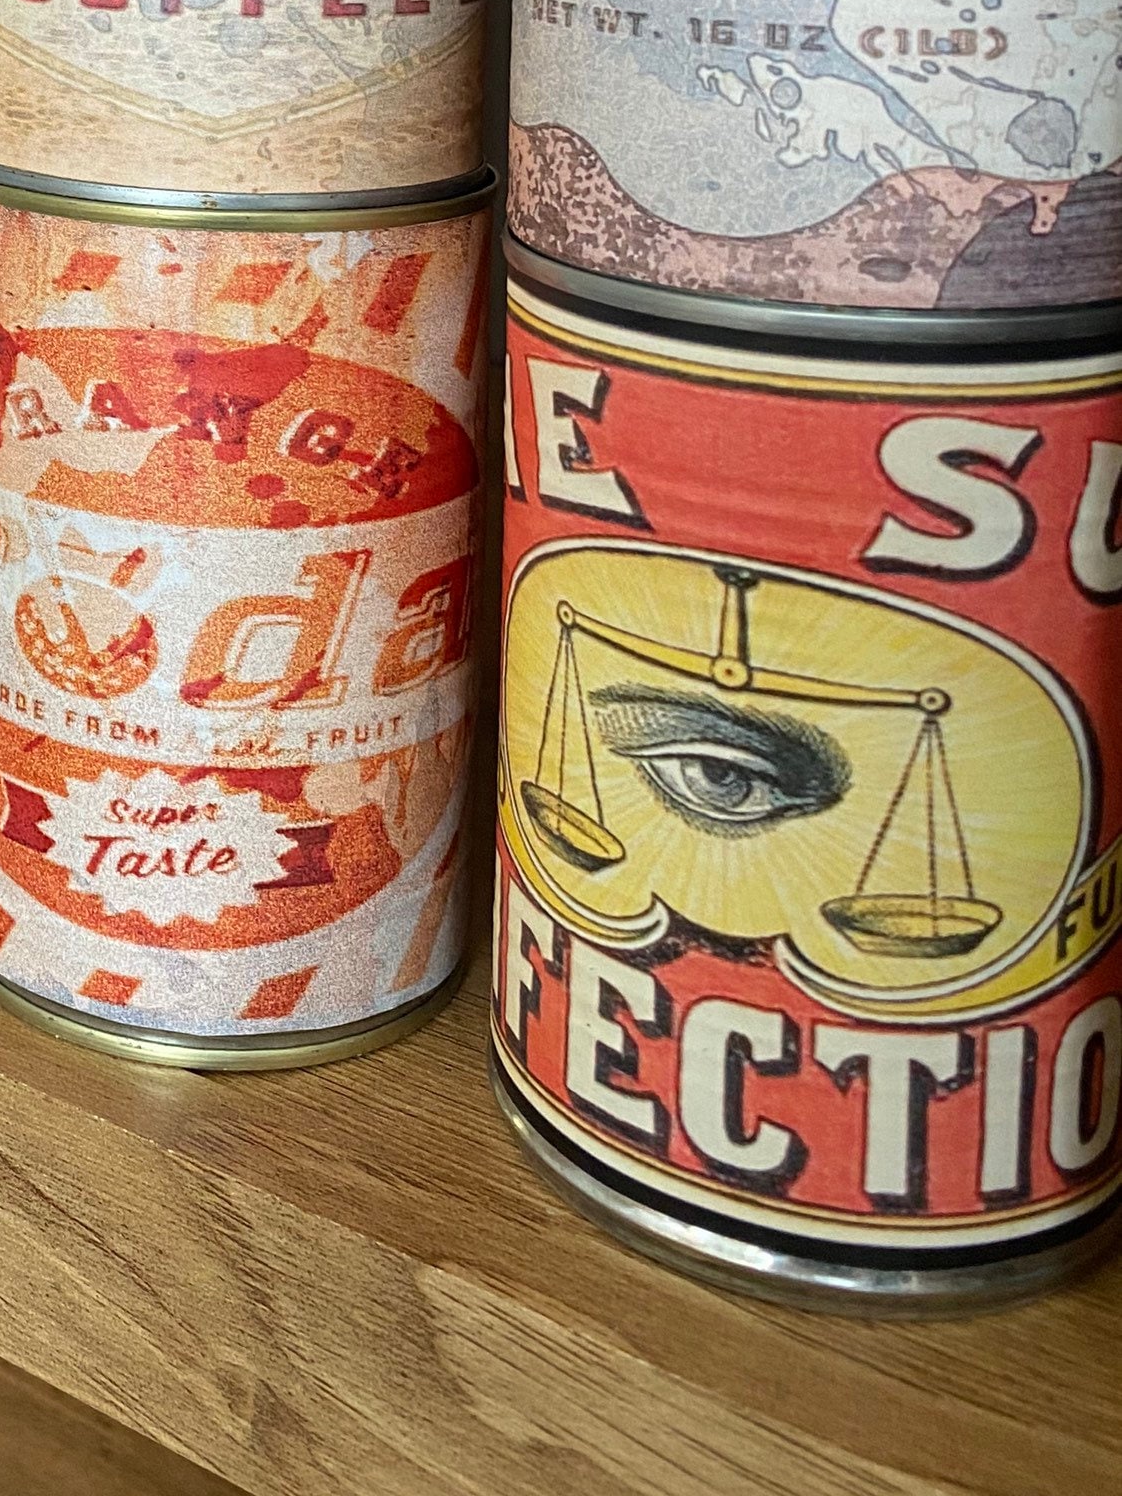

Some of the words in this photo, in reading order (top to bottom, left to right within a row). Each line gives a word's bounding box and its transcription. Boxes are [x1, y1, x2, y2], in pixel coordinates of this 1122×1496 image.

[506, 354, 654, 534] E
[65, 708, 161, 748] FROM
[306, 714, 403, 751] FRUIT
[109, 798, 219, 827] Super
[81, 833, 241, 879] Taste
[493, 874, 1122, 1217] FECTIO
